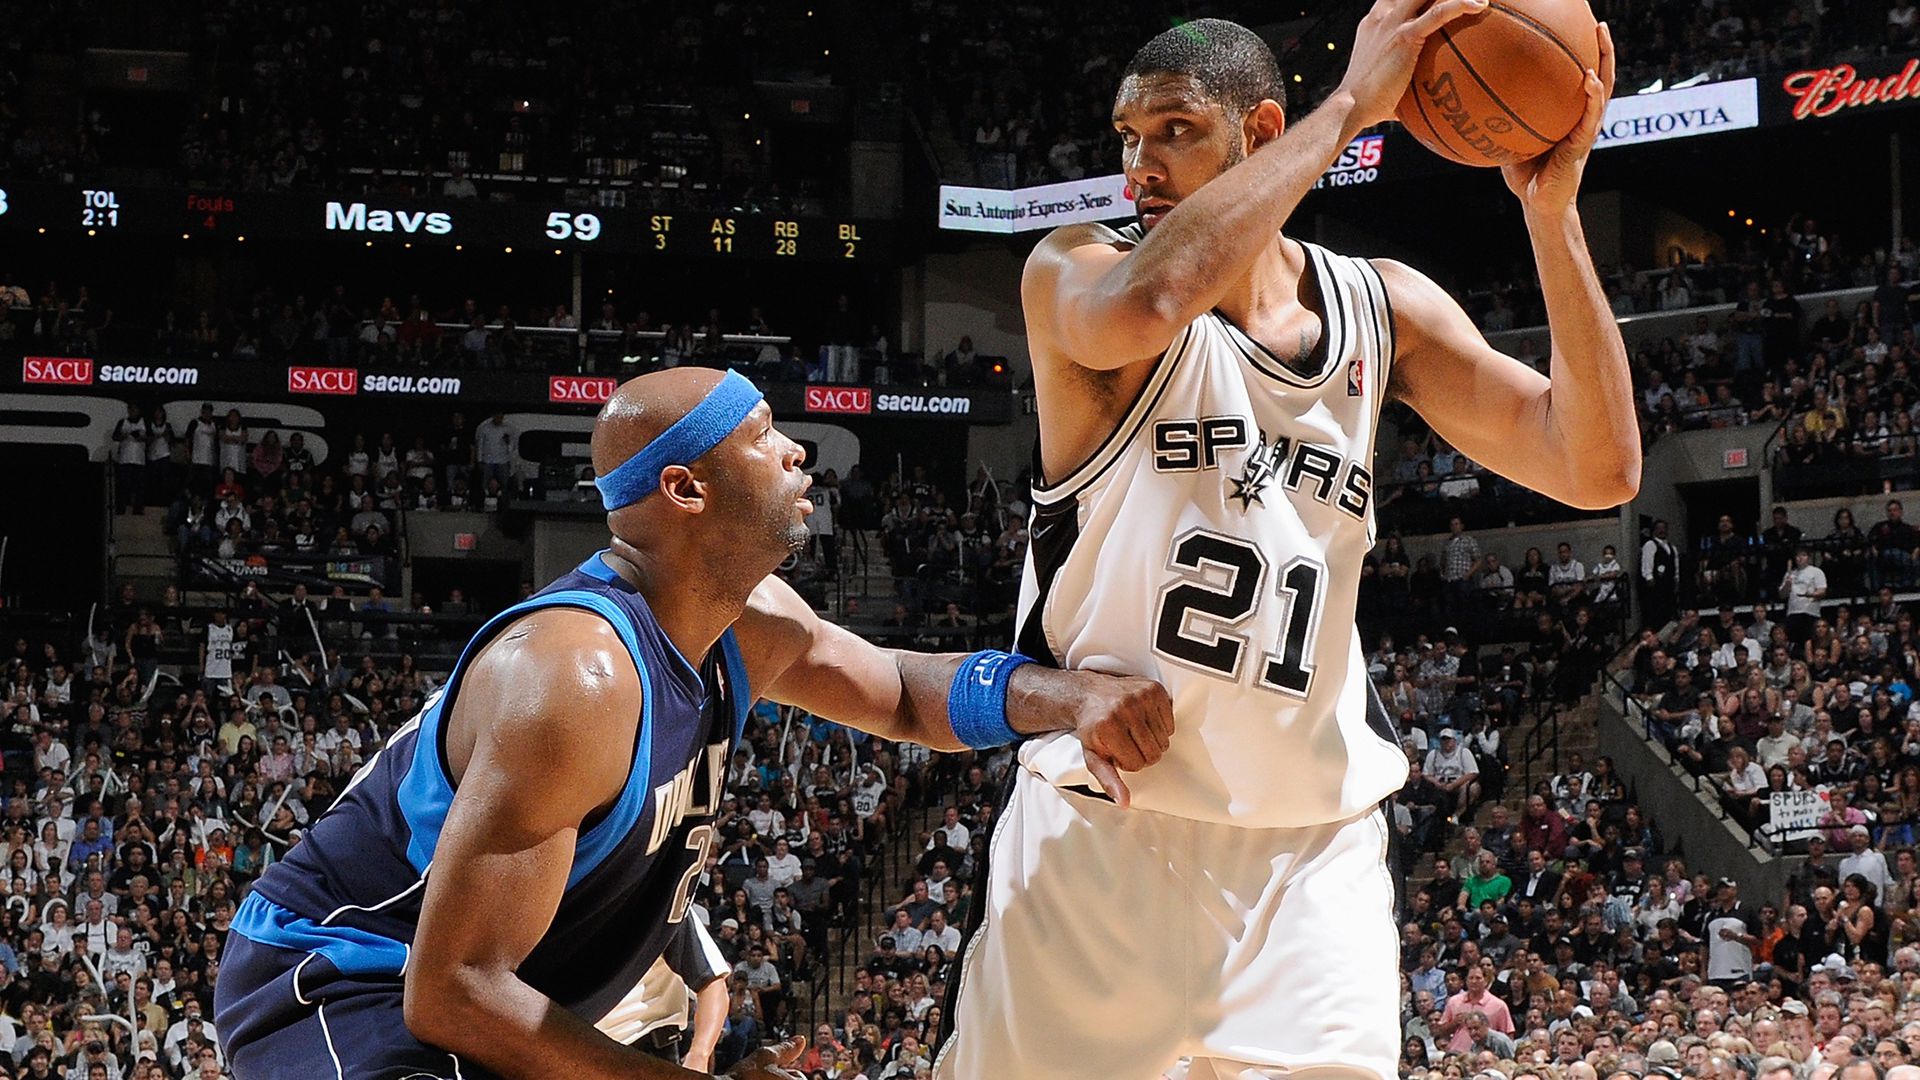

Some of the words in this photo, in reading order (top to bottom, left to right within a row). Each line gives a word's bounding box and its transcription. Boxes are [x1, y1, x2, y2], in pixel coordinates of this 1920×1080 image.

[1329, 168, 1378, 187] 10:00
[82, 190, 120, 209] TOL
[187, 195, 234, 213] Fouls
[944, 199, 972, 217] San
[973, 200, 1026, 220] Antonio
[1027, 193, 1113, 219] Express-News
[82, 208, 118, 227] 2:1
[203, 215, 216, 229] 4
[325, 202, 453, 235] Mavs
[545, 212, 601, 242] 59
[650, 216, 673, 232] ST
[711, 218, 736, 235] AS
[774, 221, 800, 238] RB
[838, 224, 861, 241] BL
[655, 233, 667, 250] 3
[713, 237, 733, 253] 11
[776, 239, 797, 256] 28
[844, 242, 856, 258] 2
[26, 360, 91, 382] SACU
[99, 364, 198, 385] sacu.com
[291, 369, 355, 392] SACU
[363, 374, 461, 395] sacu.com
[552, 378, 615, 401] SACU
[807, 389, 870, 411] SACU
[876, 393, 970, 414] sacu.com
[1150, 525, 1329, 703] 21
